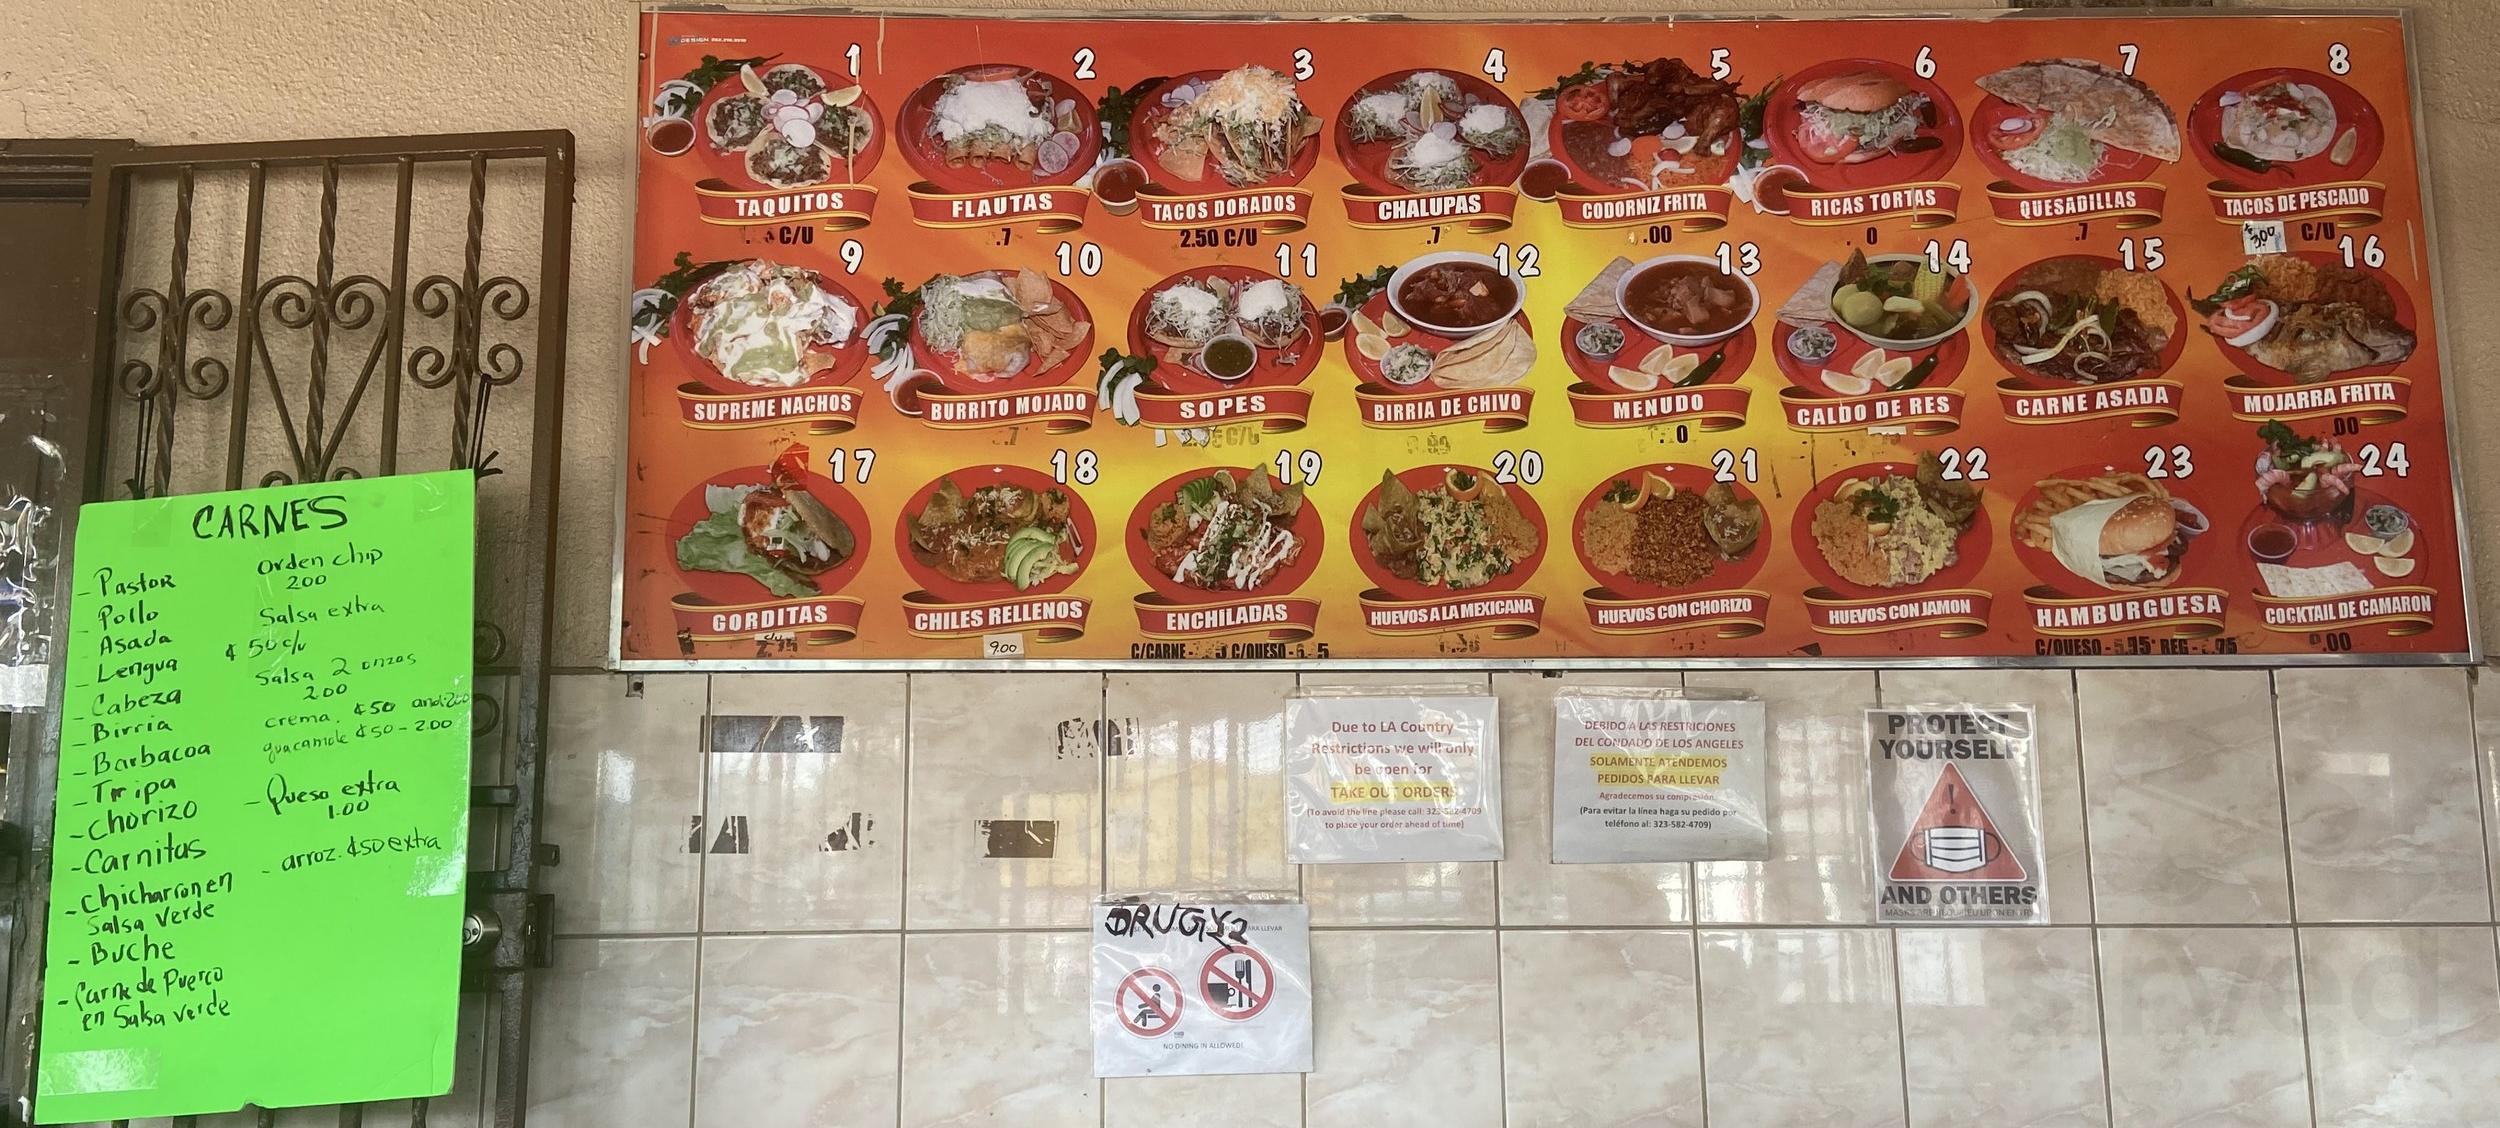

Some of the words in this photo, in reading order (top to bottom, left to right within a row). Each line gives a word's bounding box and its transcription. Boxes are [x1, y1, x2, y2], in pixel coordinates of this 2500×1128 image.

[845, 43, 861, 77] 1
[1073, 47, 1097, 80] 2
[1293, 48, 1314, 81] 3
[1483, 47, 1507, 83] 4
[1710, 47, 1732, 81] 5
[1914, 45, 1937, 79] 6
[2119, 43, 2139, 76] 7
[2327, 42, 2352, 75] 8
[735, 192, 844, 217] TAQUITOS
[952, 193, 1054, 218] FLAUTAS
[1152, 200, 1209, 222] TACOS
[1214, 194, 1297, 219] DORADOS
[1378, 194, 1482, 220] CHALUPAS
[1582, 197, 1661, 220] CODORNIZ
[1663, 193, 1707, 214] FRITA
[1811, 194, 1864, 217] RICAS
[1869, 189, 1937, 213] TORTAS
[2020, 191, 2137, 219] QUESADILLAS
[2223, 194, 2274, 217] TACOS
[2277, 192, 2297, 214] DE
[2300, 187, 2370, 210] PESCADO
[779, 226, 814, 245] C/U
[1180, 228, 1219, 248] 2.50
[1224, 227, 1258, 247] C/U
[2301, 222, 2336, 241] C/U
[840, 240, 864, 274] 9
[1055, 241, 1103, 277] 10
[1275, 243, 1318, 278] 11
[1493, 243, 1540, 278] 12
[1715, 241, 1762, 276] 13
[1924, 239, 1971, 274] 14
[2118, 237, 2166, 271] 15
[2338, 234, 2386, 268] 16
[694, 400, 776, 421] SUPREME
[781, 394, 852, 416] NACHOS
[931, 399, 1009, 421] BURRITO
[1015, 393, 1087, 415] MOJADO
[1180, 395, 1266, 419] SOPES
[1374, 400, 1434, 422] BIRRIA
[1440, 399, 1461, 417] DE
[1467, 394, 1521, 413] CHIVO
[1613, 394, 1704, 419] MENUDO
[1797, 403, 1866, 426] CALDO
[1876, 400, 1901, 420] DE
[1910, 396, 1951, 415] RES
[2016, 393, 2088, 416] CARNE
[2095, 386, 2169, 409] ASADA
[2244, 388, 2336, 413] MOJARRA
[2341, 383, 2396, 405] FRITA
[828, 448, 877, 484] 17
[1050, 448, 1099, 484] 18
[1275, 449, 1324, 486] 19
[1492, 449, 1544, 485] 20
[1711, 448, 1759, 482] 21
[1938, 447, 1990, 481] 22
[2144, 445, 2194, 479] 23
[2358, 442, 2410, 478] 24
[192, 495, 348, 539] CARNES
[328, 594, 385, 617] extra
[712, 605, 828, 632] GORDITAS
[914, 608, 984, 632] CHILES
[988, 601, 1084, 626] RELLENOS
[1167, 604, 1288, 630] ENCHILADAS
[1371, 607, 1429, 626] HUEVOS
[1430, 607, 1440, 622] A
[1441, 606, 1459, 621] LA
[1460, 599, 1535, 619] MEXICANA
[1598, 604, 1655, 625] HUEVOS
[1657, 602, 1687, 619] CON
[1689, 598, 1752, 616] CHORIZO
[1829, 606, 1887, 625] HUEVOS
[1889, 605, 1919, 620] CON
[1921, 600, 1971, 617] JAMON
[2037, 595, 2222, 627] HAMBURGUESA
[2265, 605, 2336, 624] COCKTAIL
[2339, 602, 2358, 619] DE
[2359, 595, 2431, 616] CAMARON
[331, 658, 351, 676] 2
[1332, 722, 1358, 733] Due
[1361, 722, 1376, 733] to
[1380, 722, 1395, 733] LA
[1400, 722, 1453, 735] Country
[1585, 720, 1626, 731] DEBIDO
[1638, 721, 1658, 731] LAS
[1888, 714, 2009, 735] PROTECT
[1575, 737, 1595, 747] DEL
[1597, 737, 1653, 748] CONDADO
[1672, 738, 1693, 748] LOS
[1695, 739, 1744, 749] ANGELES
[1355, 764, 1371, 775] be
[1590, 756, 1655, 767] SOLAMENTE
[1658, 757, 1727, 768] ATENDEMOS
[1331, 787, 1365, 799] TAKE
[1598, 774, 1644, 784] PEDIDOS
[1647, 774, 1676, 784] PARA
[1679, 775, 1720, 785] LLEVAR
[1600, 791, 1653, 802] Agradecemos
[1336, 821, 1357, 831] place
[1405, 821, 1430, 830] ahead
[1380, 808, 1407, 819] please
[1603, 806, 1627, 816] evitar
[1659, 808, 1680, 818] haga
[1692, 808, 1721, 818] pedido
[1605, 819, 1639, 829] teléfono
[1881, 886, 1932, 905] AND
[1941, 886, 2038, 905] OTHERS
[83, 1010, 105, 1031] en
